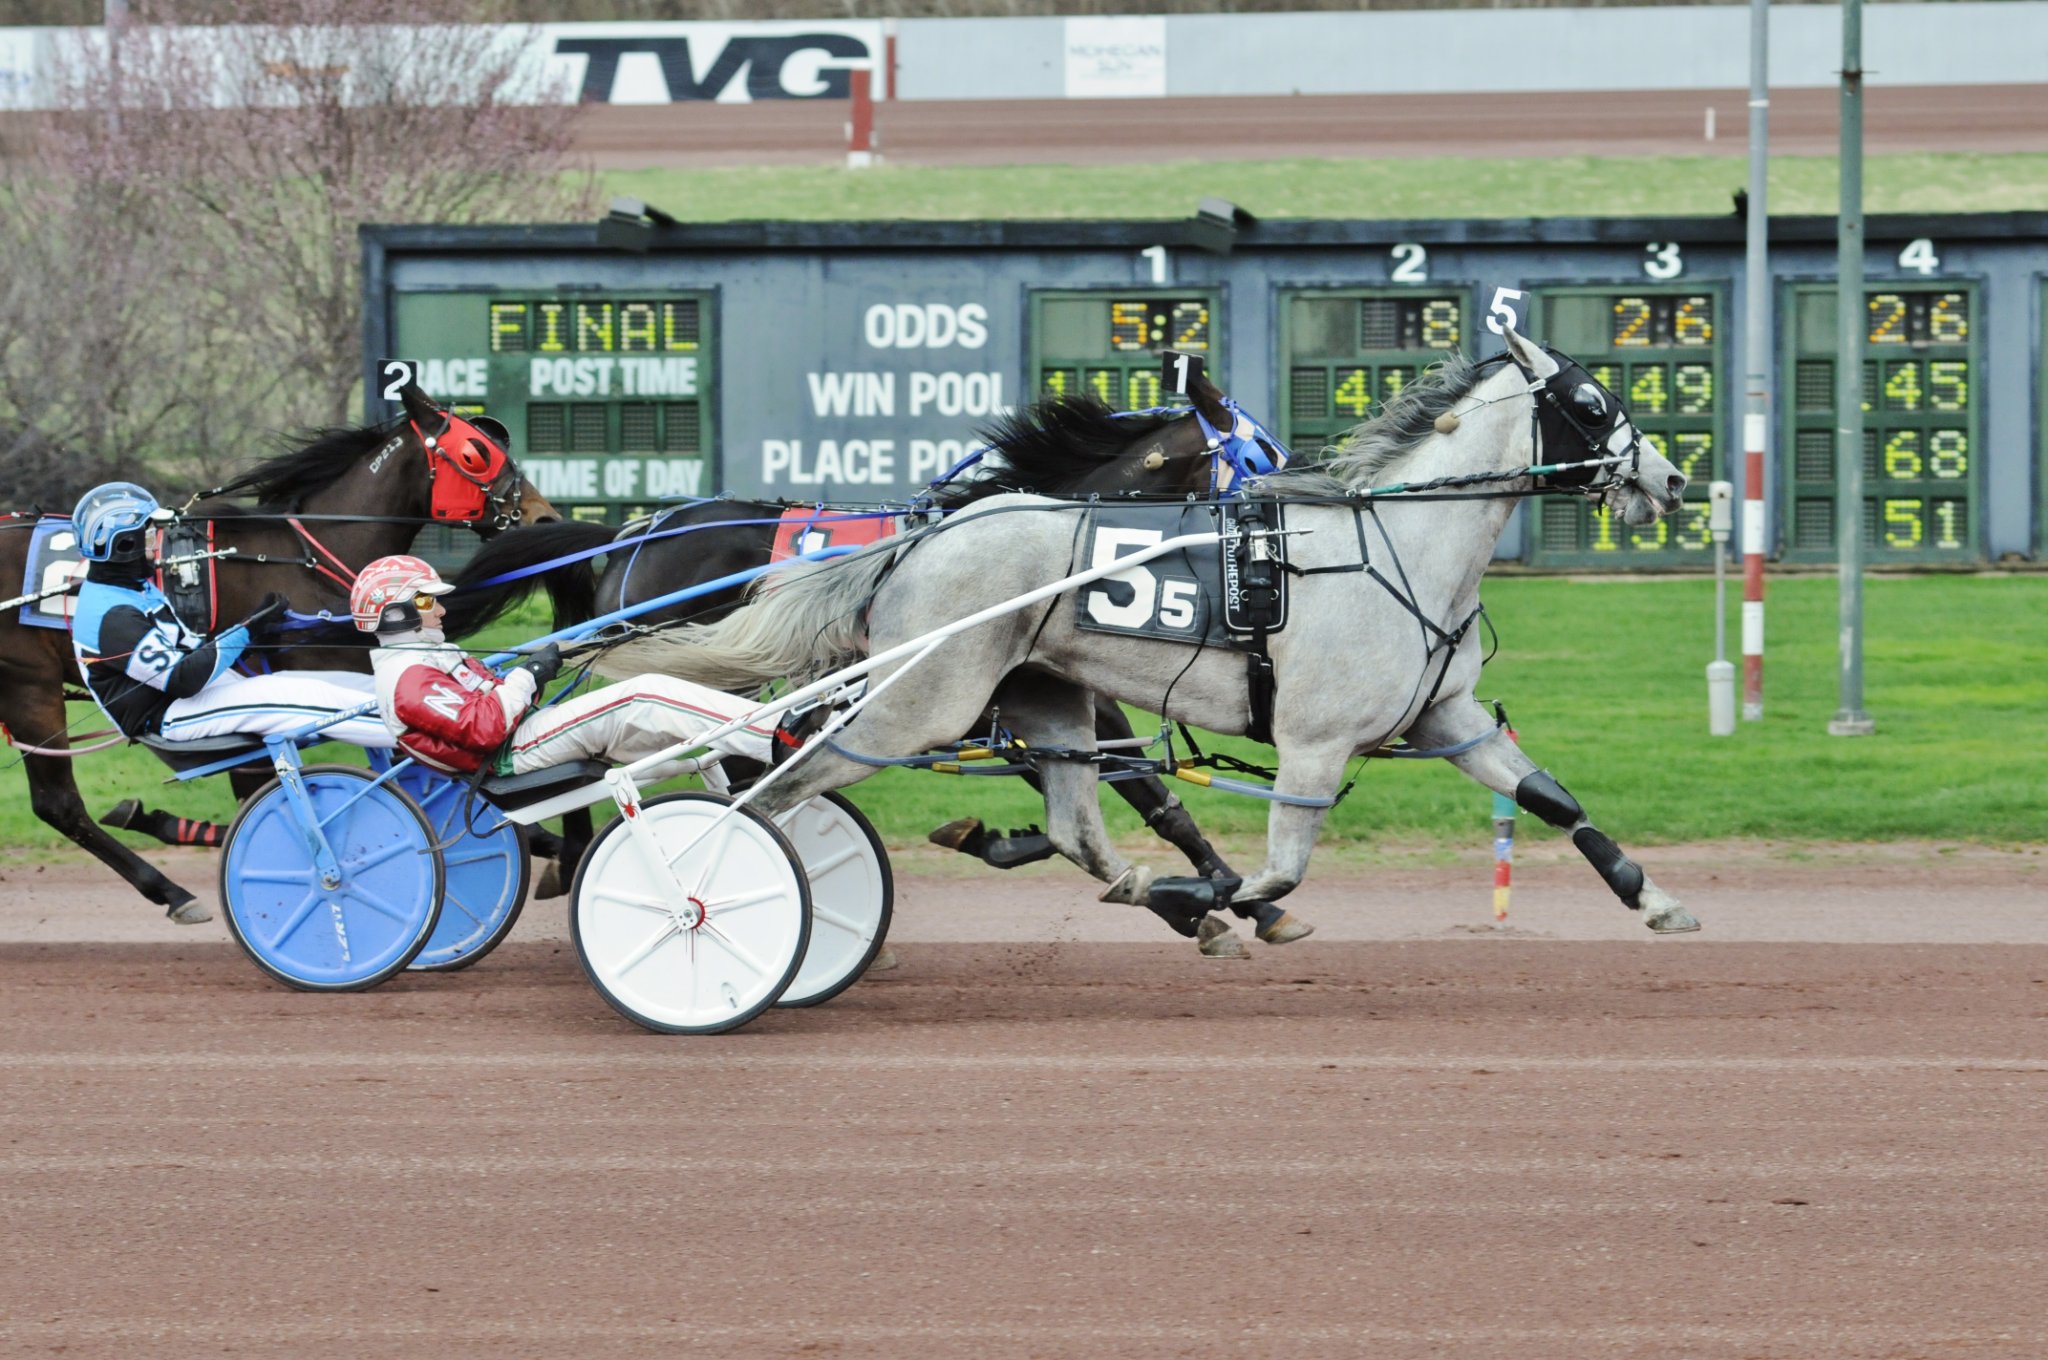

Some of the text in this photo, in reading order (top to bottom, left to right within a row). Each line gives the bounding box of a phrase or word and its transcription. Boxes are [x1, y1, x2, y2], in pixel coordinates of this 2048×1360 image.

[555, 34, 869, 101] TVG
[1141, 246, 1166, 283] 1
[1391, 244, 1427, 282] 2
[1645, 242, 1682, 279] 3
[1899, 239, 1939, 274] 4
[491, 304, 698, 351] FINAL
[865, 303, 988, 349] ODDS
[1112, 303, 1208, 349] 5:2
[1486, 286, 1521, 335] 5
[384, 361, 412, 400] 2
[531, 358, 698, 396] POST TIME
[807, 371, 1015, 417] WIN POOL
[1174, 355, 1189, 394] 1
[1885, 362, 1967, 410] 45
[762, 440, 895, 484] PLACE
[1885, 430, 1967, 479] 68
[522, 459, 704, 497] TIME OF DAY
[1885, 499, 1967, 548] 51
[1088, 526, 1198, 629] 5 5
[424, 683, 465, 721] N
